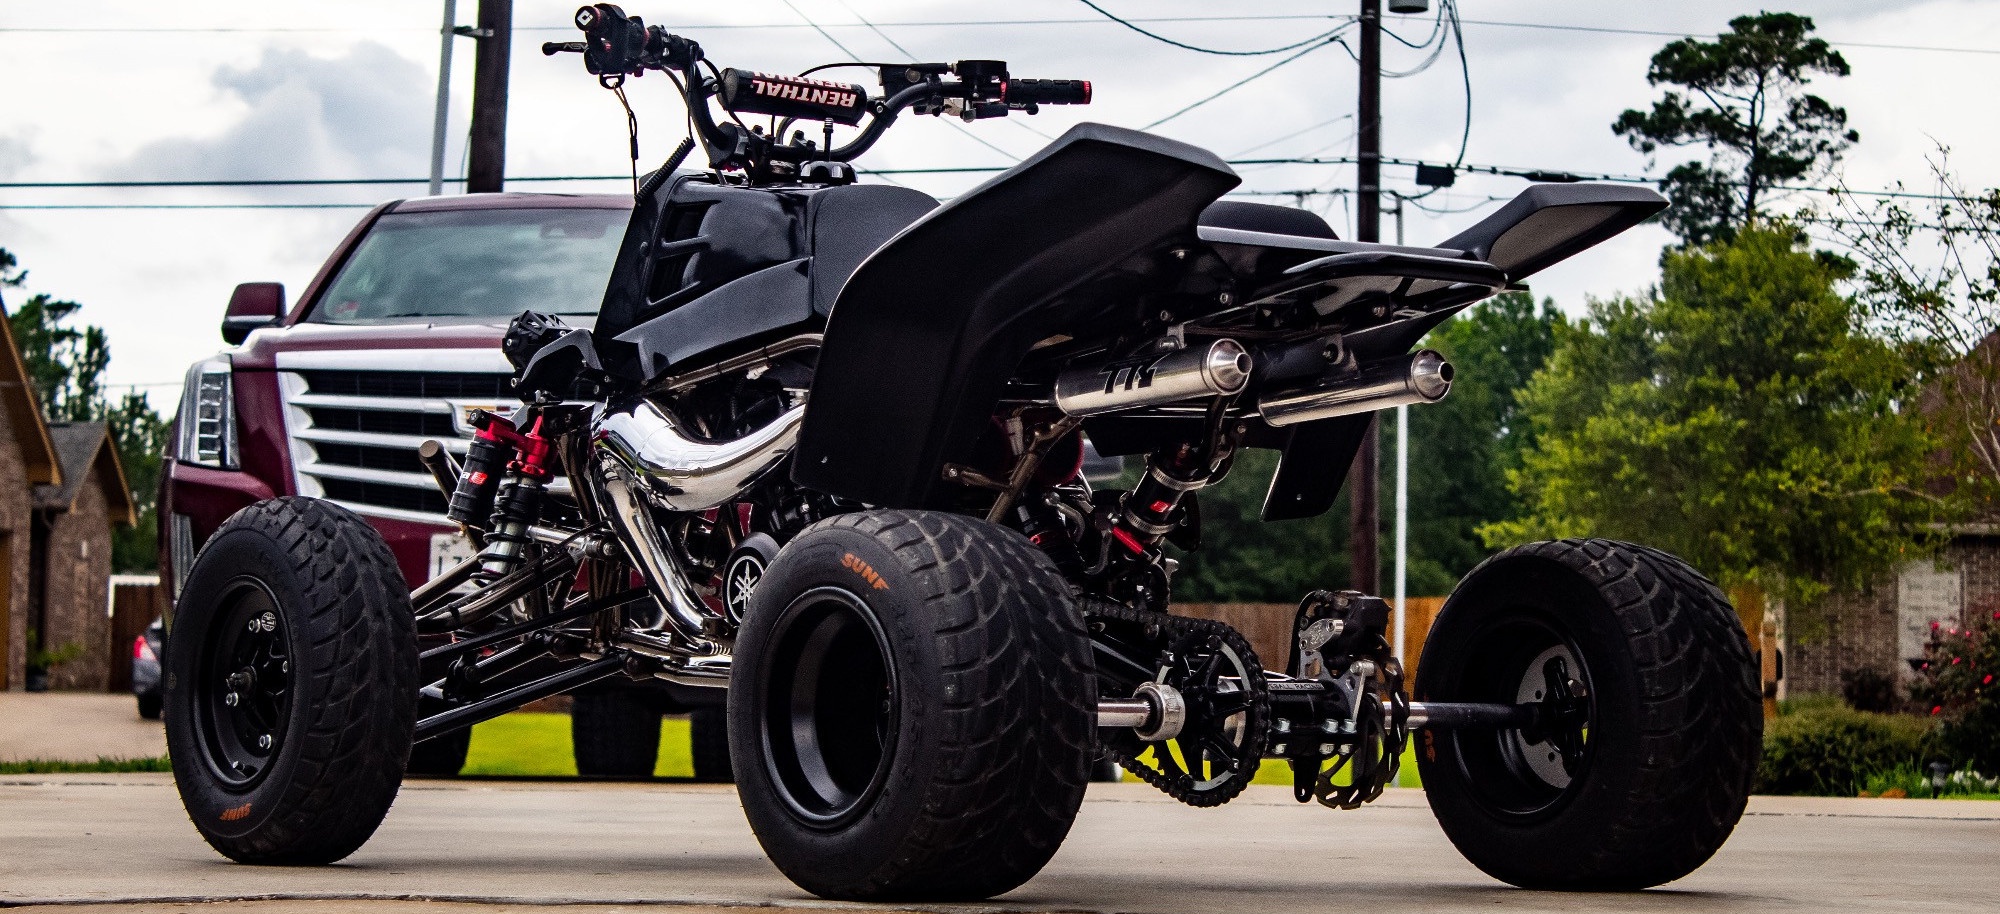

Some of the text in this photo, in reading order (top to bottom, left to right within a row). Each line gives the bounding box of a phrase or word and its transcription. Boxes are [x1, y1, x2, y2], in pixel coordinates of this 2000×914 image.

[753, 80, 857, 108] RENTHAL
[841, 552, 889, 590] SUNF
[219, 802, 252, 820] SUNF
